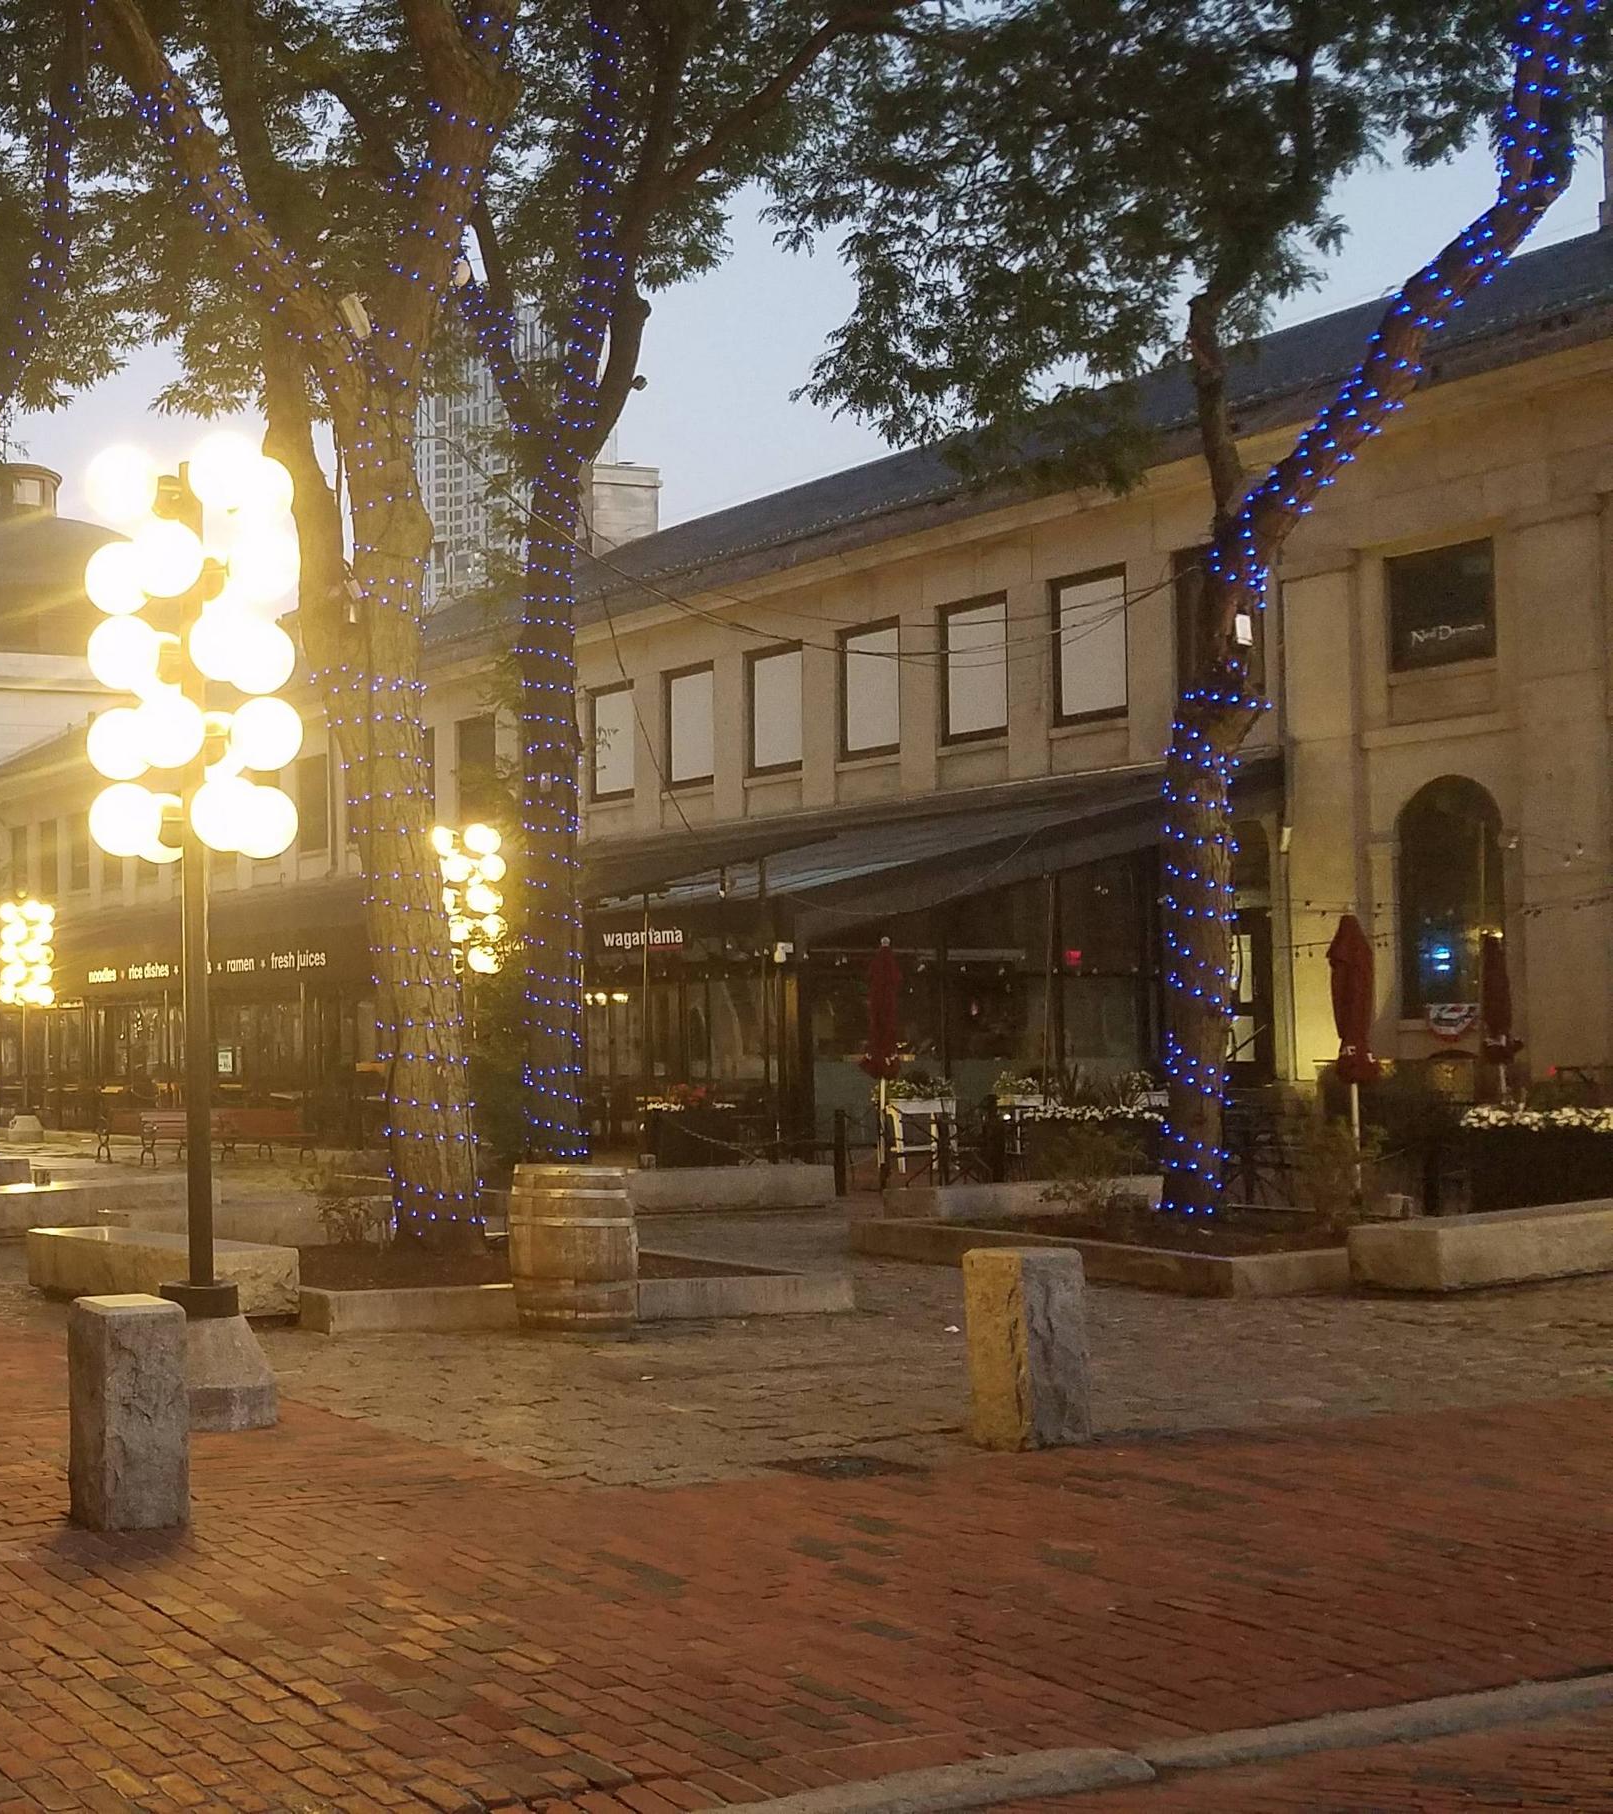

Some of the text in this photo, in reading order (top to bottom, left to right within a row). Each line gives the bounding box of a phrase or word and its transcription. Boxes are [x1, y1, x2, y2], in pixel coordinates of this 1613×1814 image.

[88, 967, 117, 984] noodles
[128, 965, 143, 980] rice
[144, 962, 170, 979] dishes
[226, 957, 255, 973] ramen
[270, 951, 295, 969] fresh
[296, 950, 327, 972] juices
